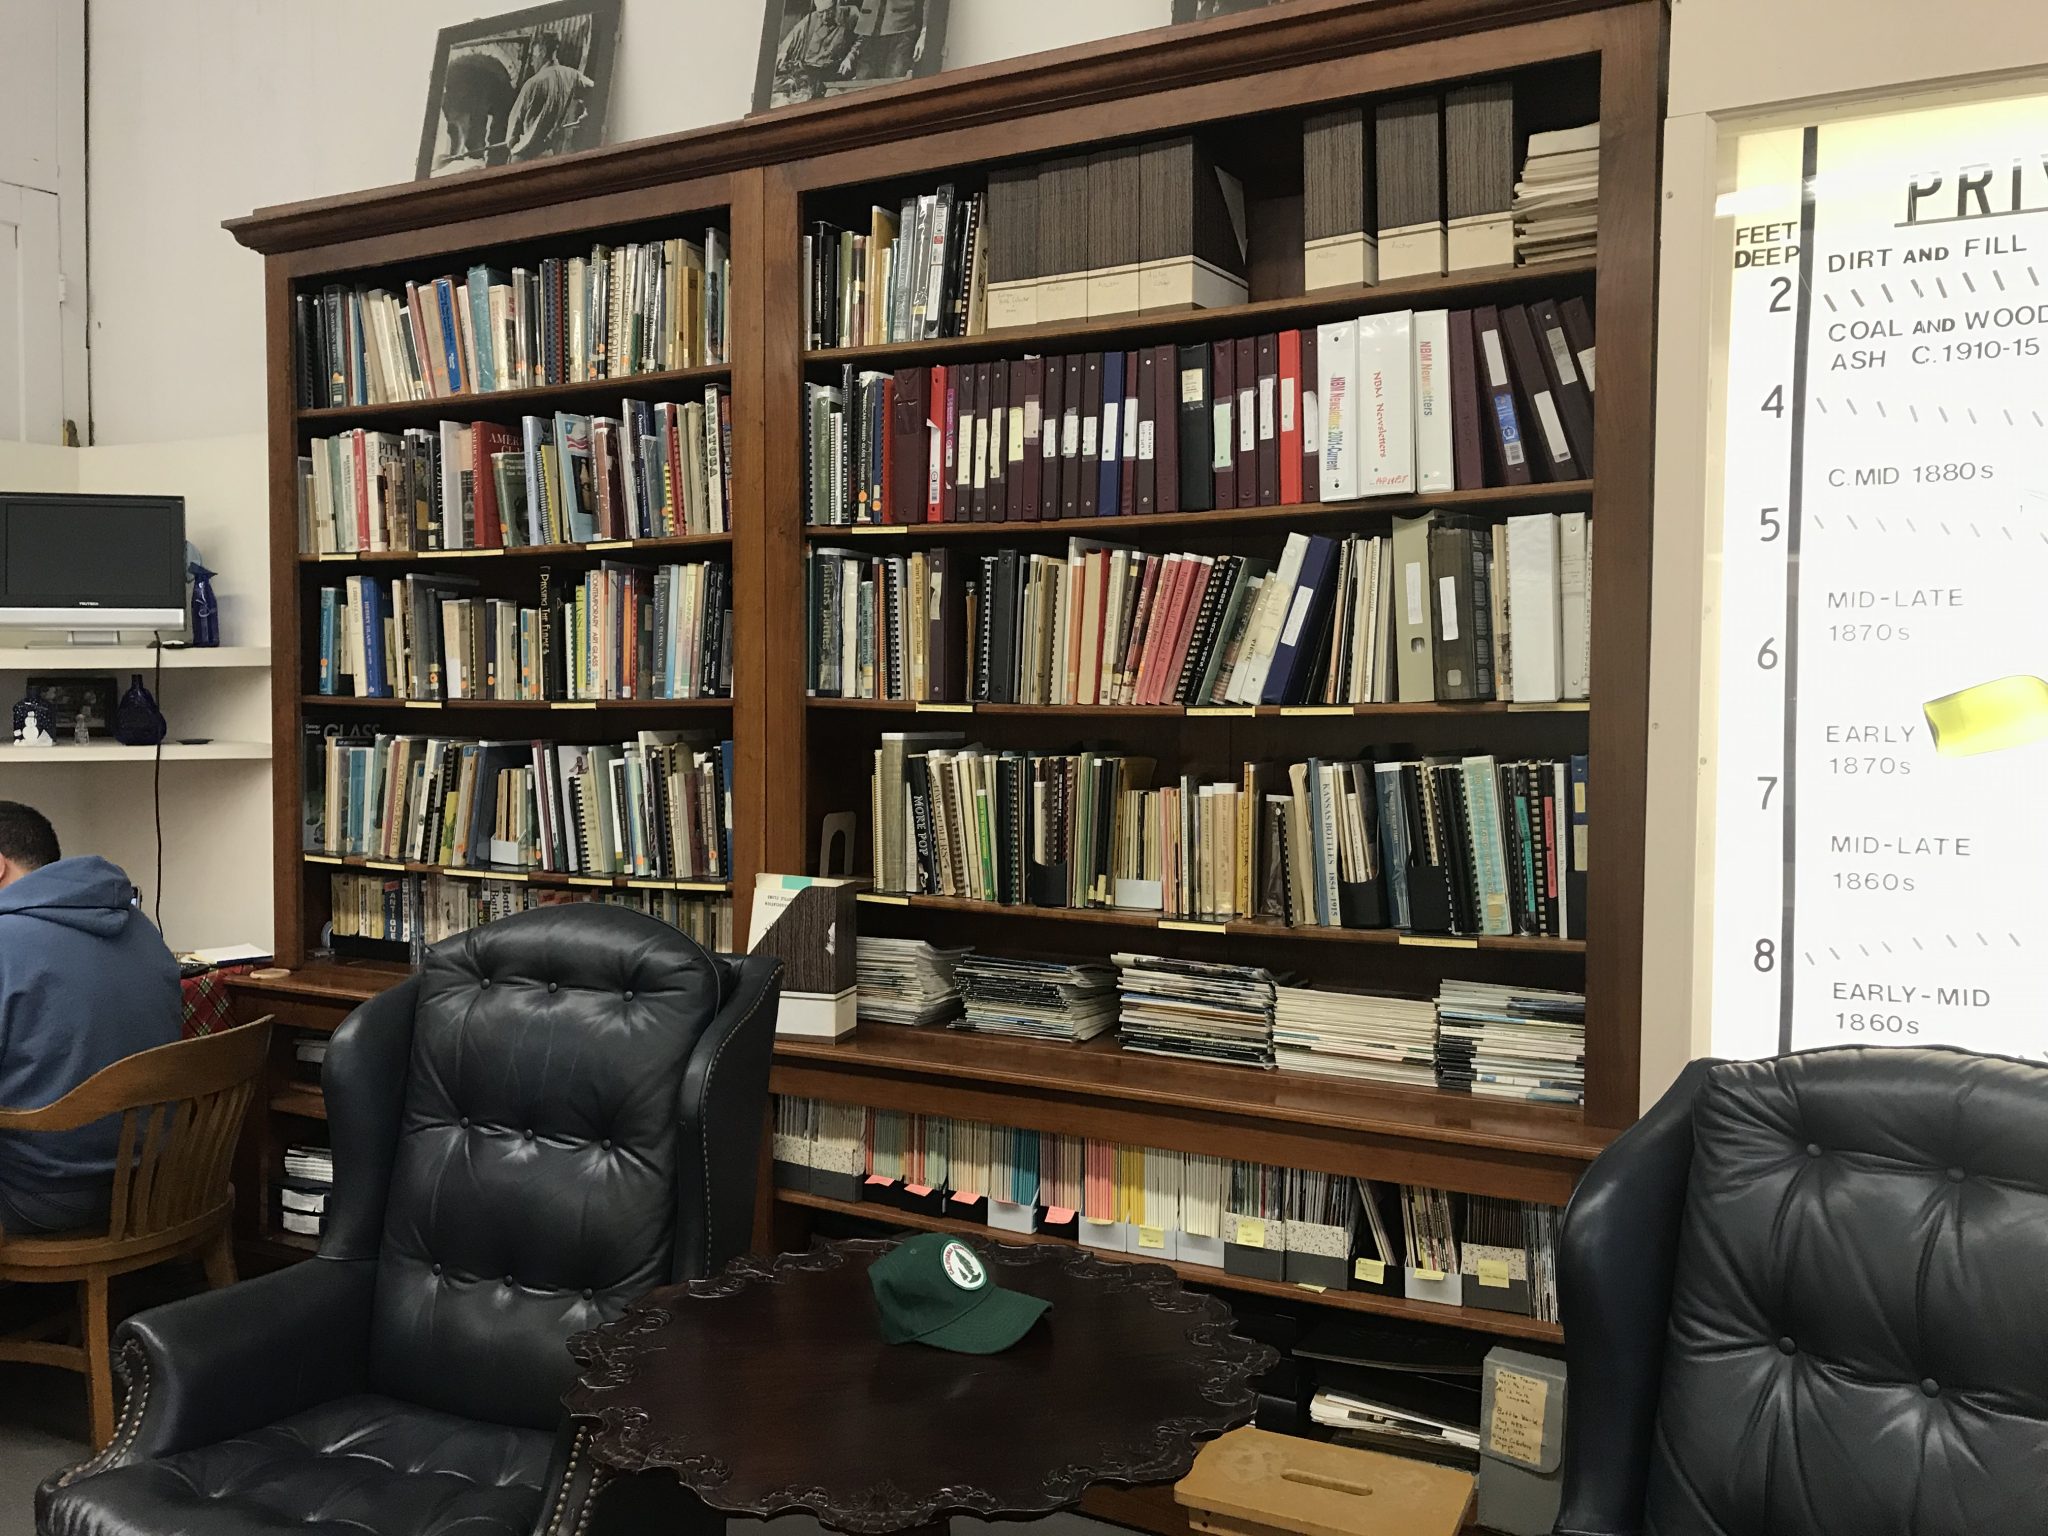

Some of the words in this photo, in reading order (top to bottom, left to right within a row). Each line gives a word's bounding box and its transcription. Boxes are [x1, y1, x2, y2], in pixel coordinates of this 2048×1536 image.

[1907, 153, 2048, 222] PRI
[1736, 222, 1797, 246] FEET
[1734, 246, 1801, 269] DEEP
[1829, 249, 1892, 272] DIRT
[1903, 247, 1949, 264] AND
[1965, 235, 2027, 257] FILL
[1769, 277, 1791, 313] 2
[1828, 320, 1903, 342] COAL
[1912, 318, 1955, 334] AND
[1964, 305, 2048, 330] WOOD
[1420, 341, 1433, 361] NBM
[1831, 351, 1885, 370] ASH
[1330, 377, 1345, 392] NBM
[1373, 371, 1382, 398] NBM
[1421, 364, 1434, 416] Newsletters
[1328, 393, 1344, 429] Newsletters
[1761, 385, 1784, 418] 4
[708, 394, 718, 477] SARATOGA
[1376, 402, 1387, 458] Newsletters
[1914, 463, 1993, 482] 1880s
[1761, 507, 1780, 541] 5
[823, 565, 833, 605] Bitters
[1829, 589, 1961, 608] MID-LATE
[591, 573, 599, 628] CONTEMPORARY
[591, 631, 599, 645] ART
[1831, 625, 1909, 641] 1870s
[591, 646, 599, 667] GLASS
[1758, 637, 1777, 669] 6
[1827, 726, 1914, 742] EARLY
[1830, 758, 1910, 774] 1870s
[1322, 783, 1333, 821] KANSAS
[1758, 777, 1777, 809] 7
[913, 795, 926, 830] MORE
[918, 832, 929, 856] POP
[1325, 823, 1335, 865] BOTTLES
[1832, 836, 1970, 855] MID-LATE
[1834, 873, 1914, 891] 1860s
[1330, 898, 1338, 916] 1915
[1754, 938, 1775, 972] 8
[1834, 983, 1989, 1006] EARLY-MID
[1836, 1013, 1918, 1034] 1860s
